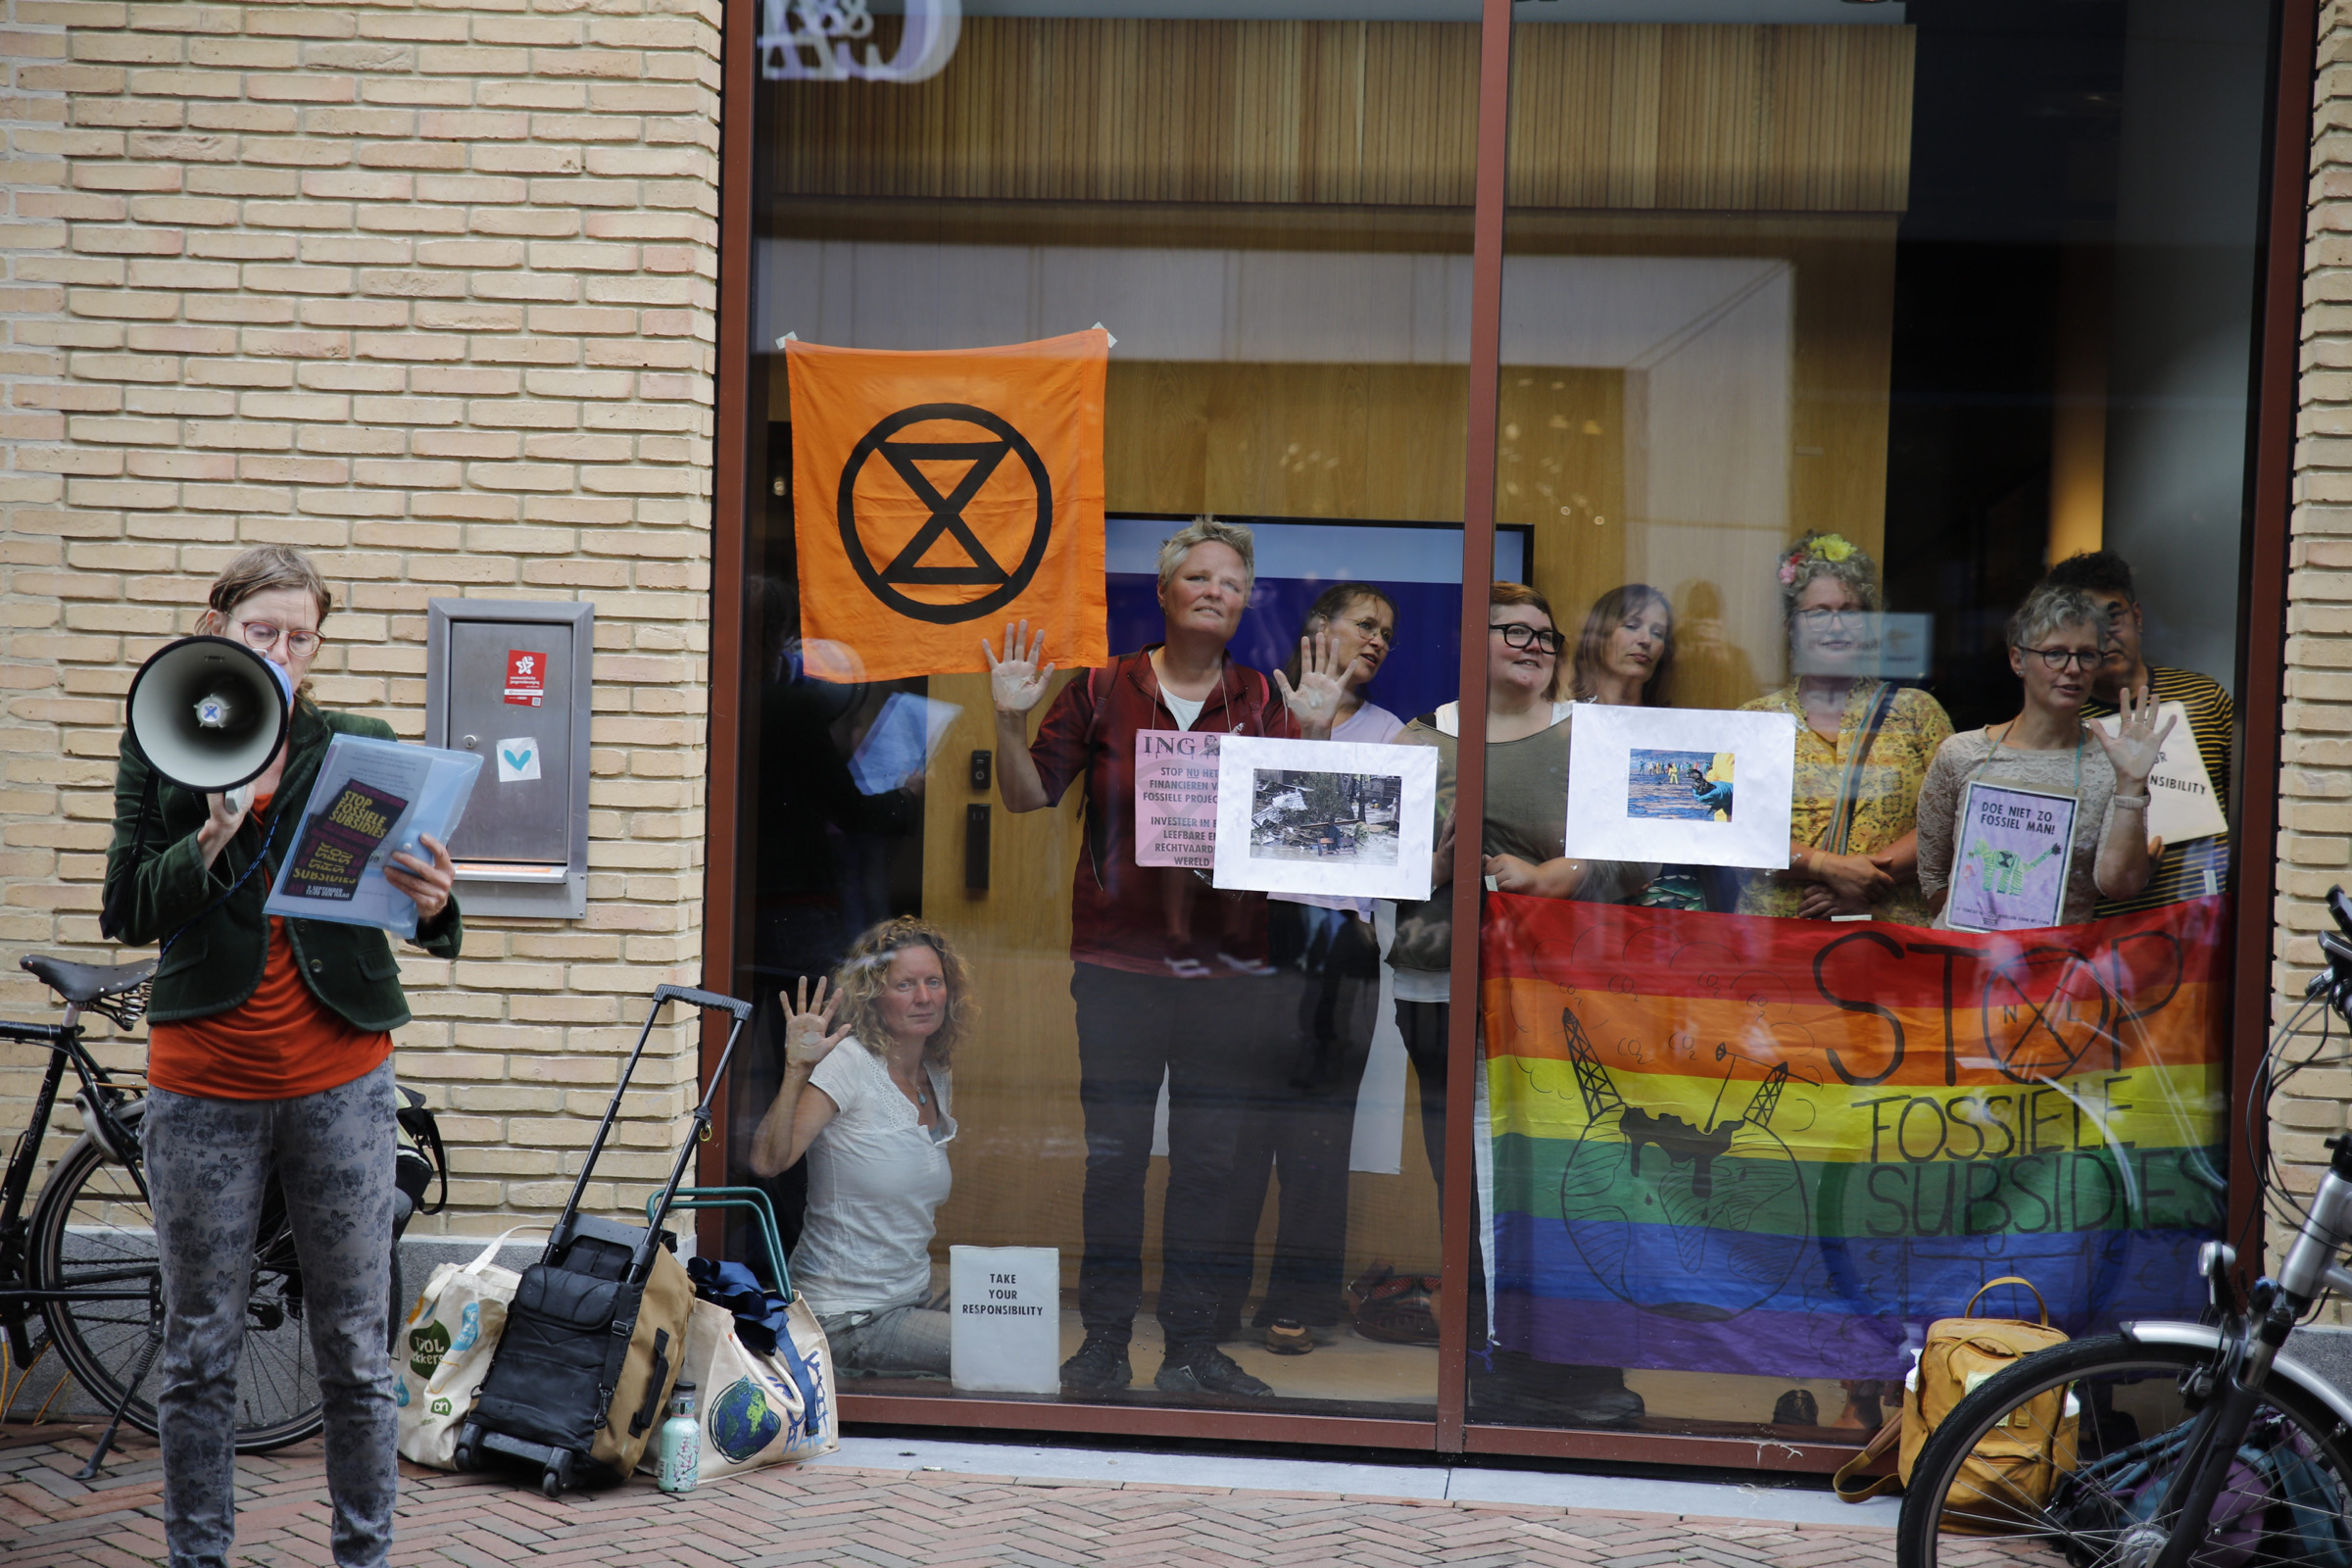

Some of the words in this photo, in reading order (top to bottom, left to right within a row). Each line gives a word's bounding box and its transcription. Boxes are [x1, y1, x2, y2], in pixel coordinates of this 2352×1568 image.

[1143, 736, 1197, 758] ING
[1160, 767, 1183, 777] STOP
[1187, 768, 1200, 778] NU
[1202, 769, 1218, 778] HET
[1150, 780, 1208, 791] FINANCIEREN
[2149, 774, 2206, 795] NSIBILITY
[342, 791, 373, 808] STOP
[1143, 792, 1182, 803] FOSSIELE
[1185, 794, 1218, 804] PROJEC
[335, 801, 387, 827] FOSSIELE
[1981, 802, 2003, 815] DOE
[2009, 807, 2032, 819] NIET
[2037, 810, 2052, 822] ZO
[329, 810, 387, 839] SUBSIDIES
[1151, 816, 1198, 828] INVESTEER
[1200, 818, 1210, 828] IN
[1981, 813, 2021, 830] FOSSIEL
[2026, 821, 2055, 835] MAN!
[1163, 829, 1205, 841] LEEFBARE
[1155, 843, 1215, 854] RECHTVAARD
[1174, 857, 1210, 866] WERELD
[1812, 930, 2183, 1088] STOP
[1850, 1075, 2135, 1164] FOSSIELE
[1866, 1150, 2223, 1239] SUBSIDIES
[990, 1273, 1016, 1285] TAKE
[988, 1289, 1017, 1300] YOUR
[962, 1303, 1043, 1316] RESPONSIBILITY
